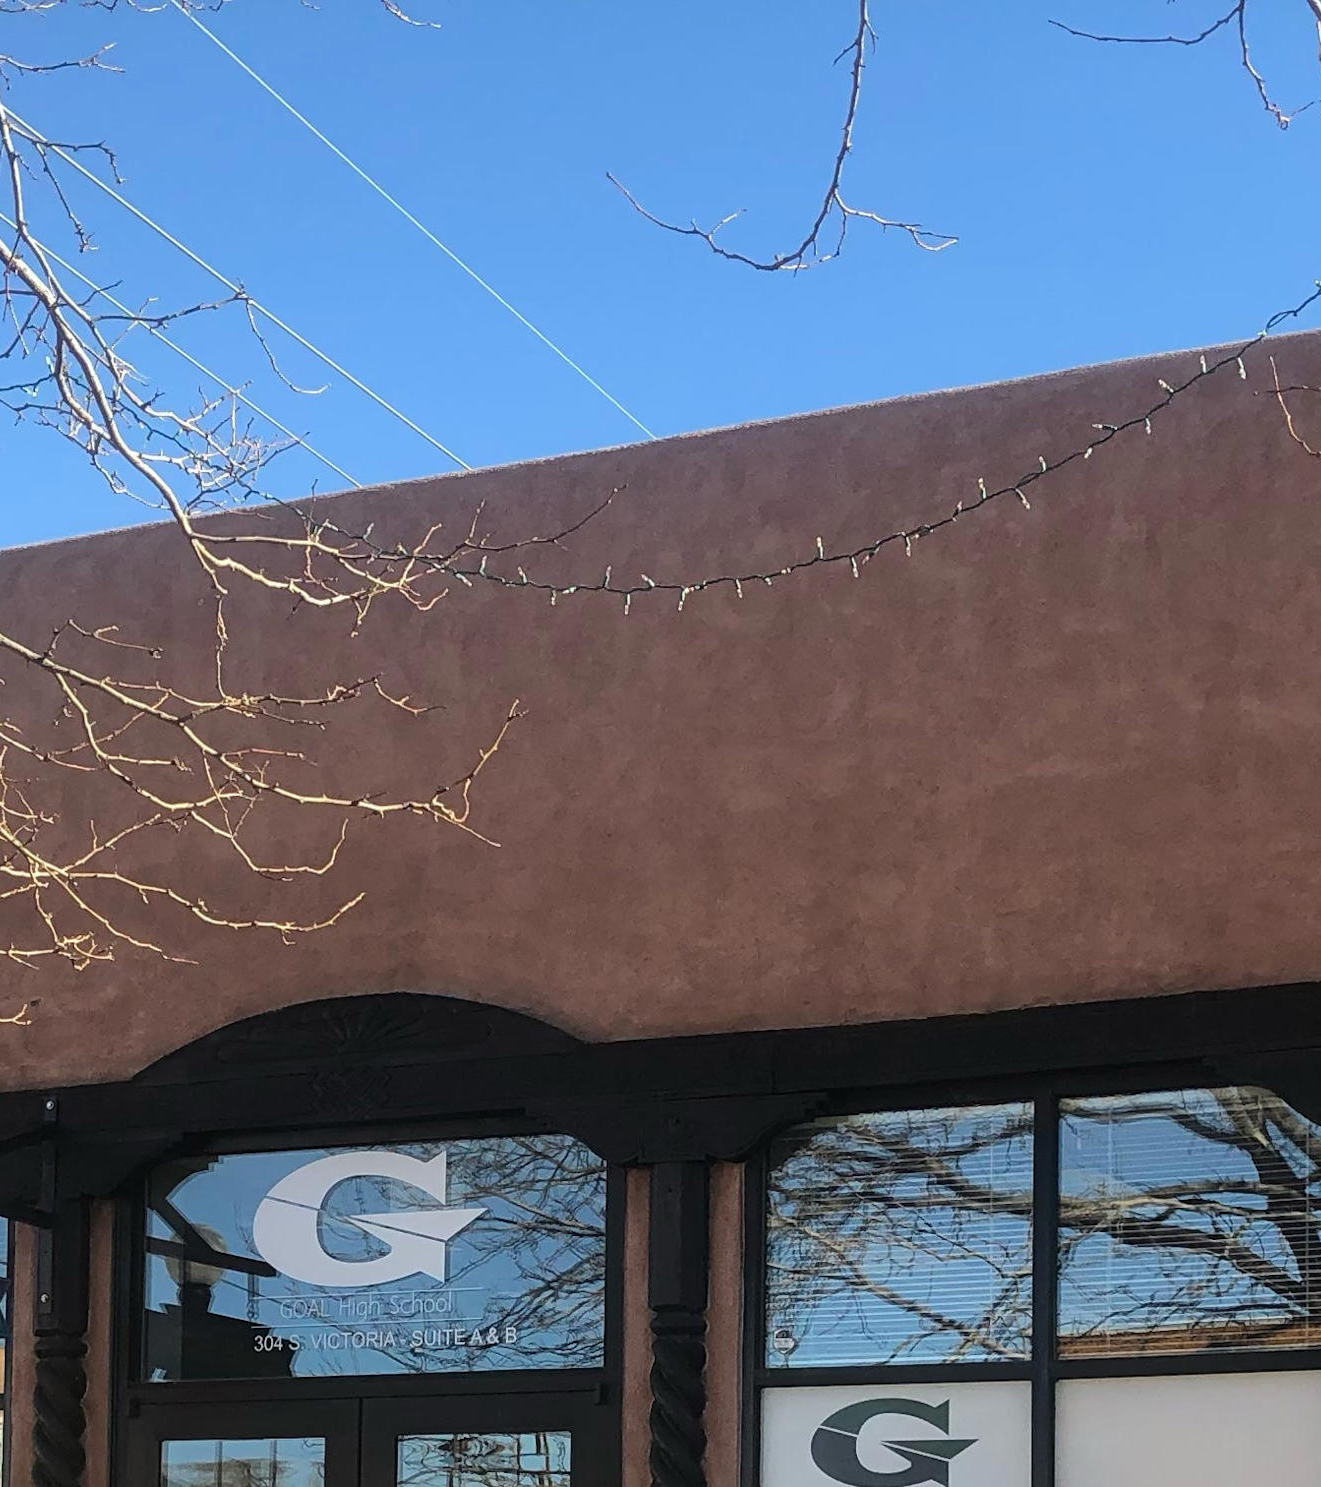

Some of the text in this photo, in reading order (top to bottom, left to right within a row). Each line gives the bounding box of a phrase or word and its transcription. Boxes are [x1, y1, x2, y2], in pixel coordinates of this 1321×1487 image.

[280, 1289, 452, 1320] GOAL High School
[254, 1334, 283, 1352] 304
[310, 1331, 396, 1350] VICTORIA
[410, 1327, 466, 1347] SUITE
[468, 1327, 484, 1345] A
[485, 1326, 500, 1344] &
[505, 1326, 518, 1344] B
